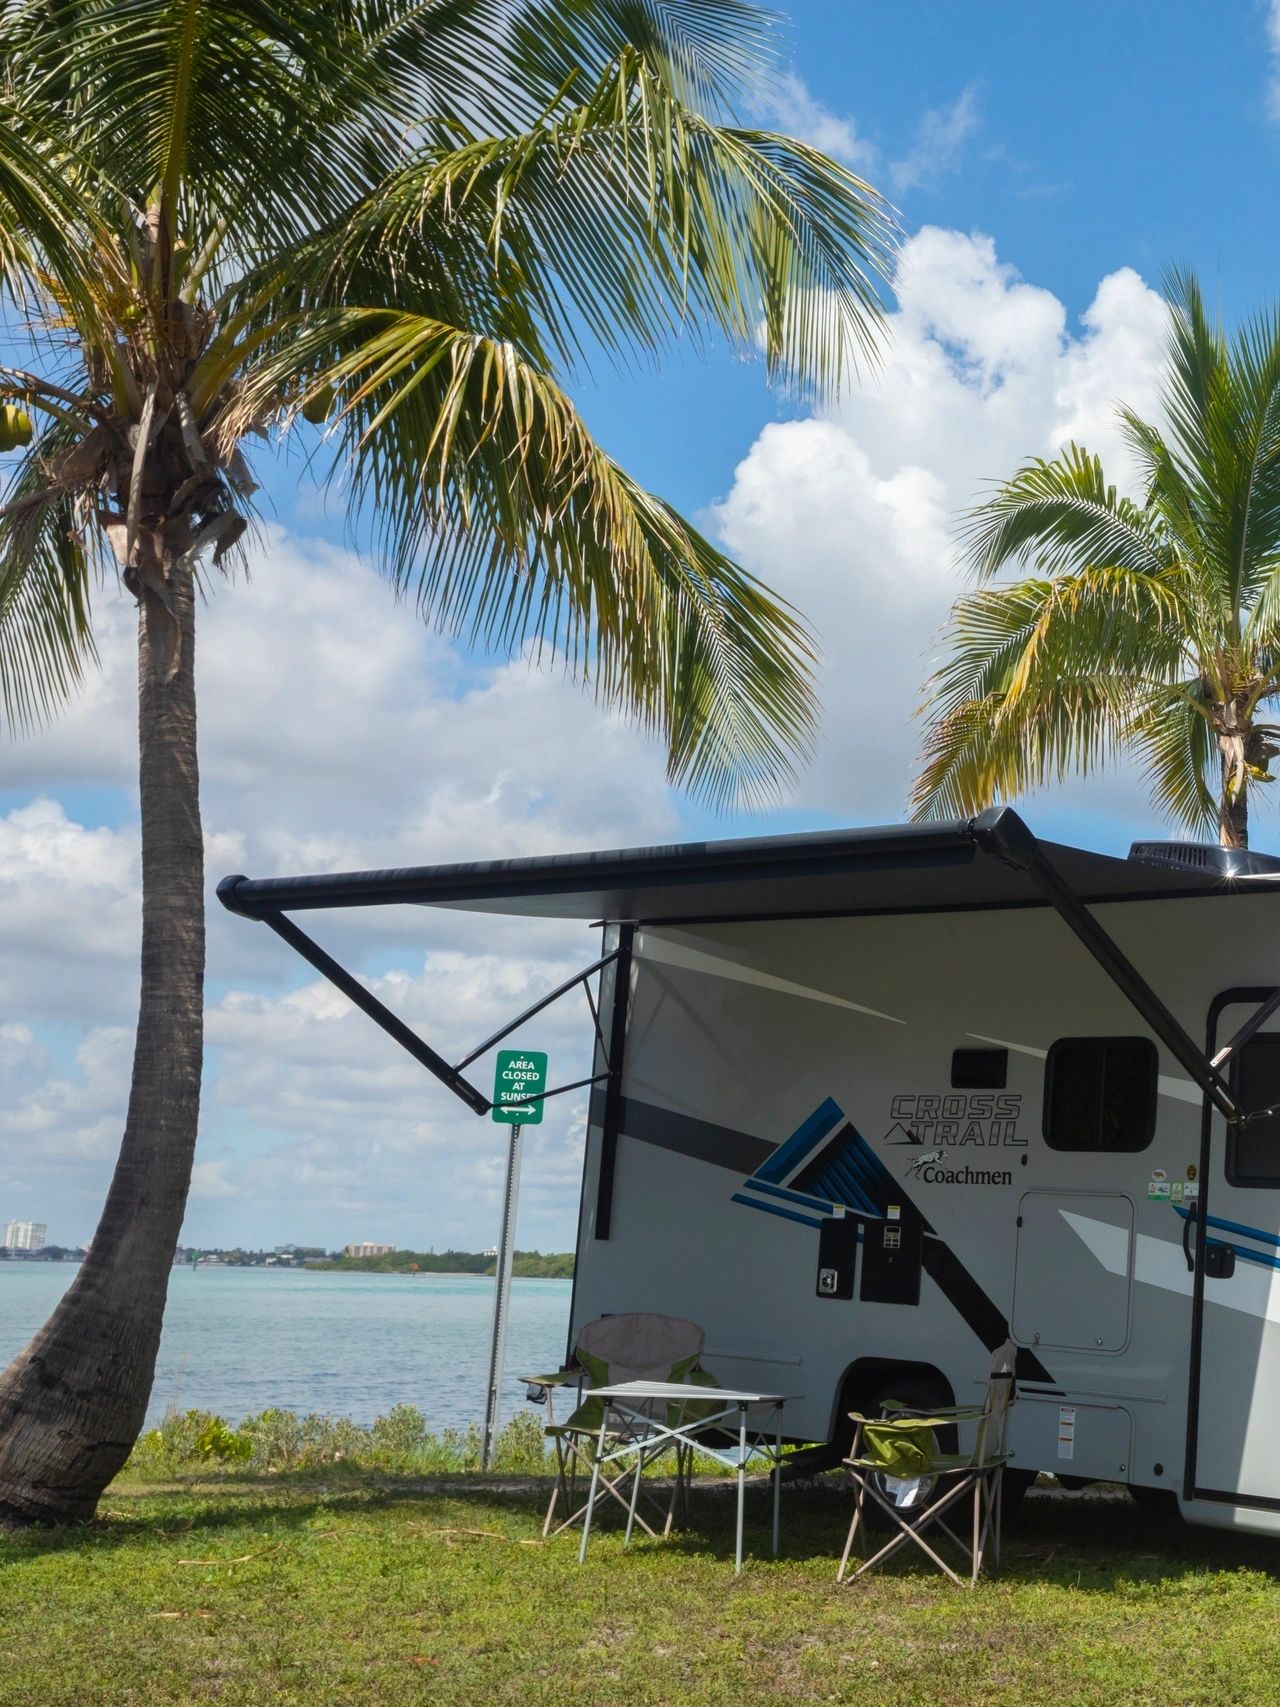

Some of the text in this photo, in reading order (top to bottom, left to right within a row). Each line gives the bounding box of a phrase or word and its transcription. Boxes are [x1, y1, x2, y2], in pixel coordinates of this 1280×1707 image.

[508, 1060, 535, 1070] AREA
[502, 1070, 540, 1081] CLOSED
[512, 1082, 525, 1090] AT
[500, 1092, 538, 1101] SUNSE
[890, 1094, 1022, 1120] CROSS
[910, 1120, 1029, 1147] TRAIL
[923, 1166, 1012, 1185] Coachmen
